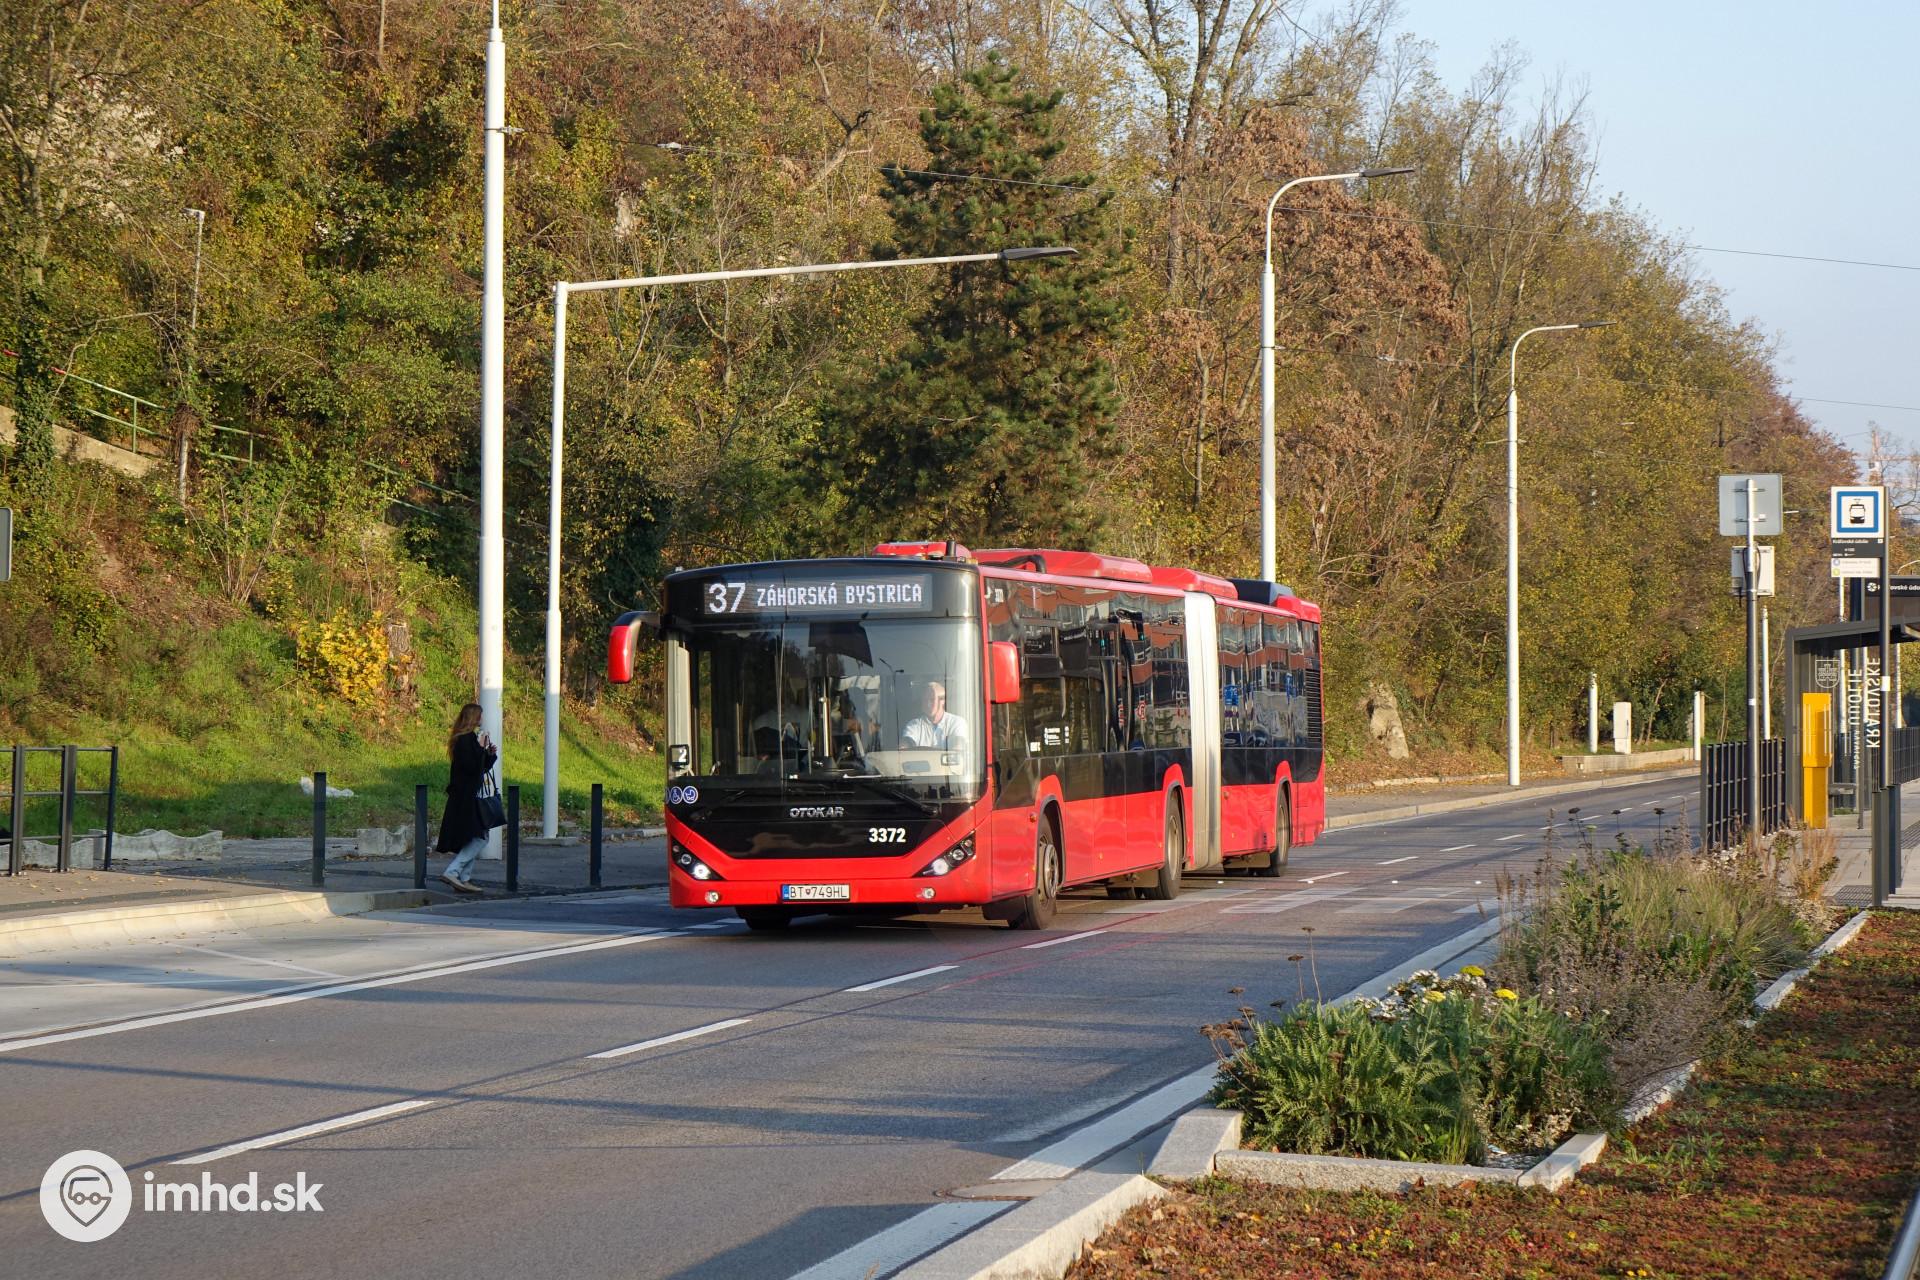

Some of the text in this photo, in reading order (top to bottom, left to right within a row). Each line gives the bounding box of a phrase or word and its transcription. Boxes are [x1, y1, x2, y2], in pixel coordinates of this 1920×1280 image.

[708, 582, 922, 613] 37 ZÁHORSKÁ BYSTRICA
[789, 806, 845, 818] OTOKAR
[868, 827, 907, 843] 3372
[790, 886, 803, 898] BT
[811, 886, 848, 898] 749HL
